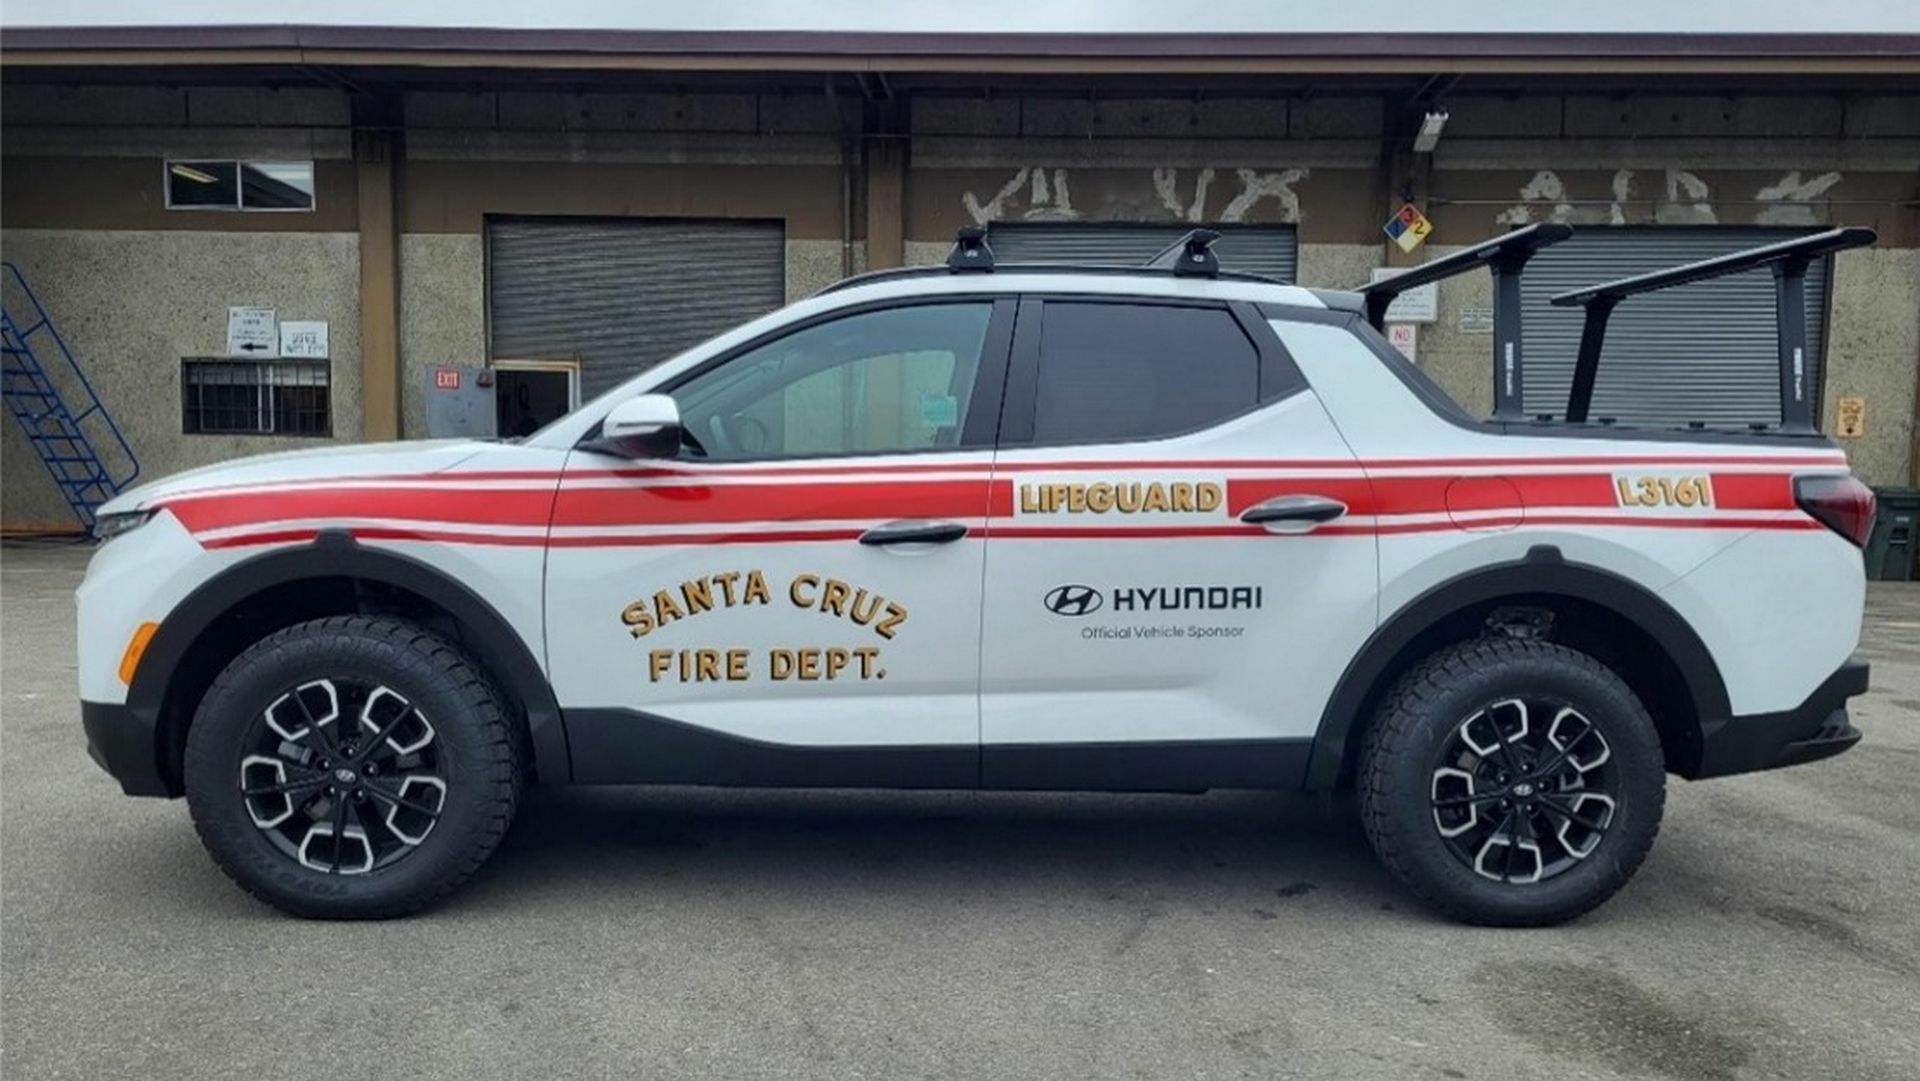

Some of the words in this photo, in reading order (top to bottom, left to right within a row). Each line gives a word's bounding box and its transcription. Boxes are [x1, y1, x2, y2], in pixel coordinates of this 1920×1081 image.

[1414, 220, 1425, 235] 2
[1394, 327, 1410, 341] NO
[437, 371, 458, 388] EXIT
[1020, 482, 1223, 513] LIFEGUARD
[1618, 476, 1711, 507] L3161
[621, 570, 771, 638] SANTA
[789, 573, 908, 640] CRUZ
[1113, 586, 1262, 611] HYUNDAI
[1081, 626, 1131, 639] Official
[1134, 625, 1184, 638] Vehicle
[1187, 625, 1245, 639] Sponsor
[649, 649, 749, 682] FIRE
[770, 649, 887, 681] DEPT.
